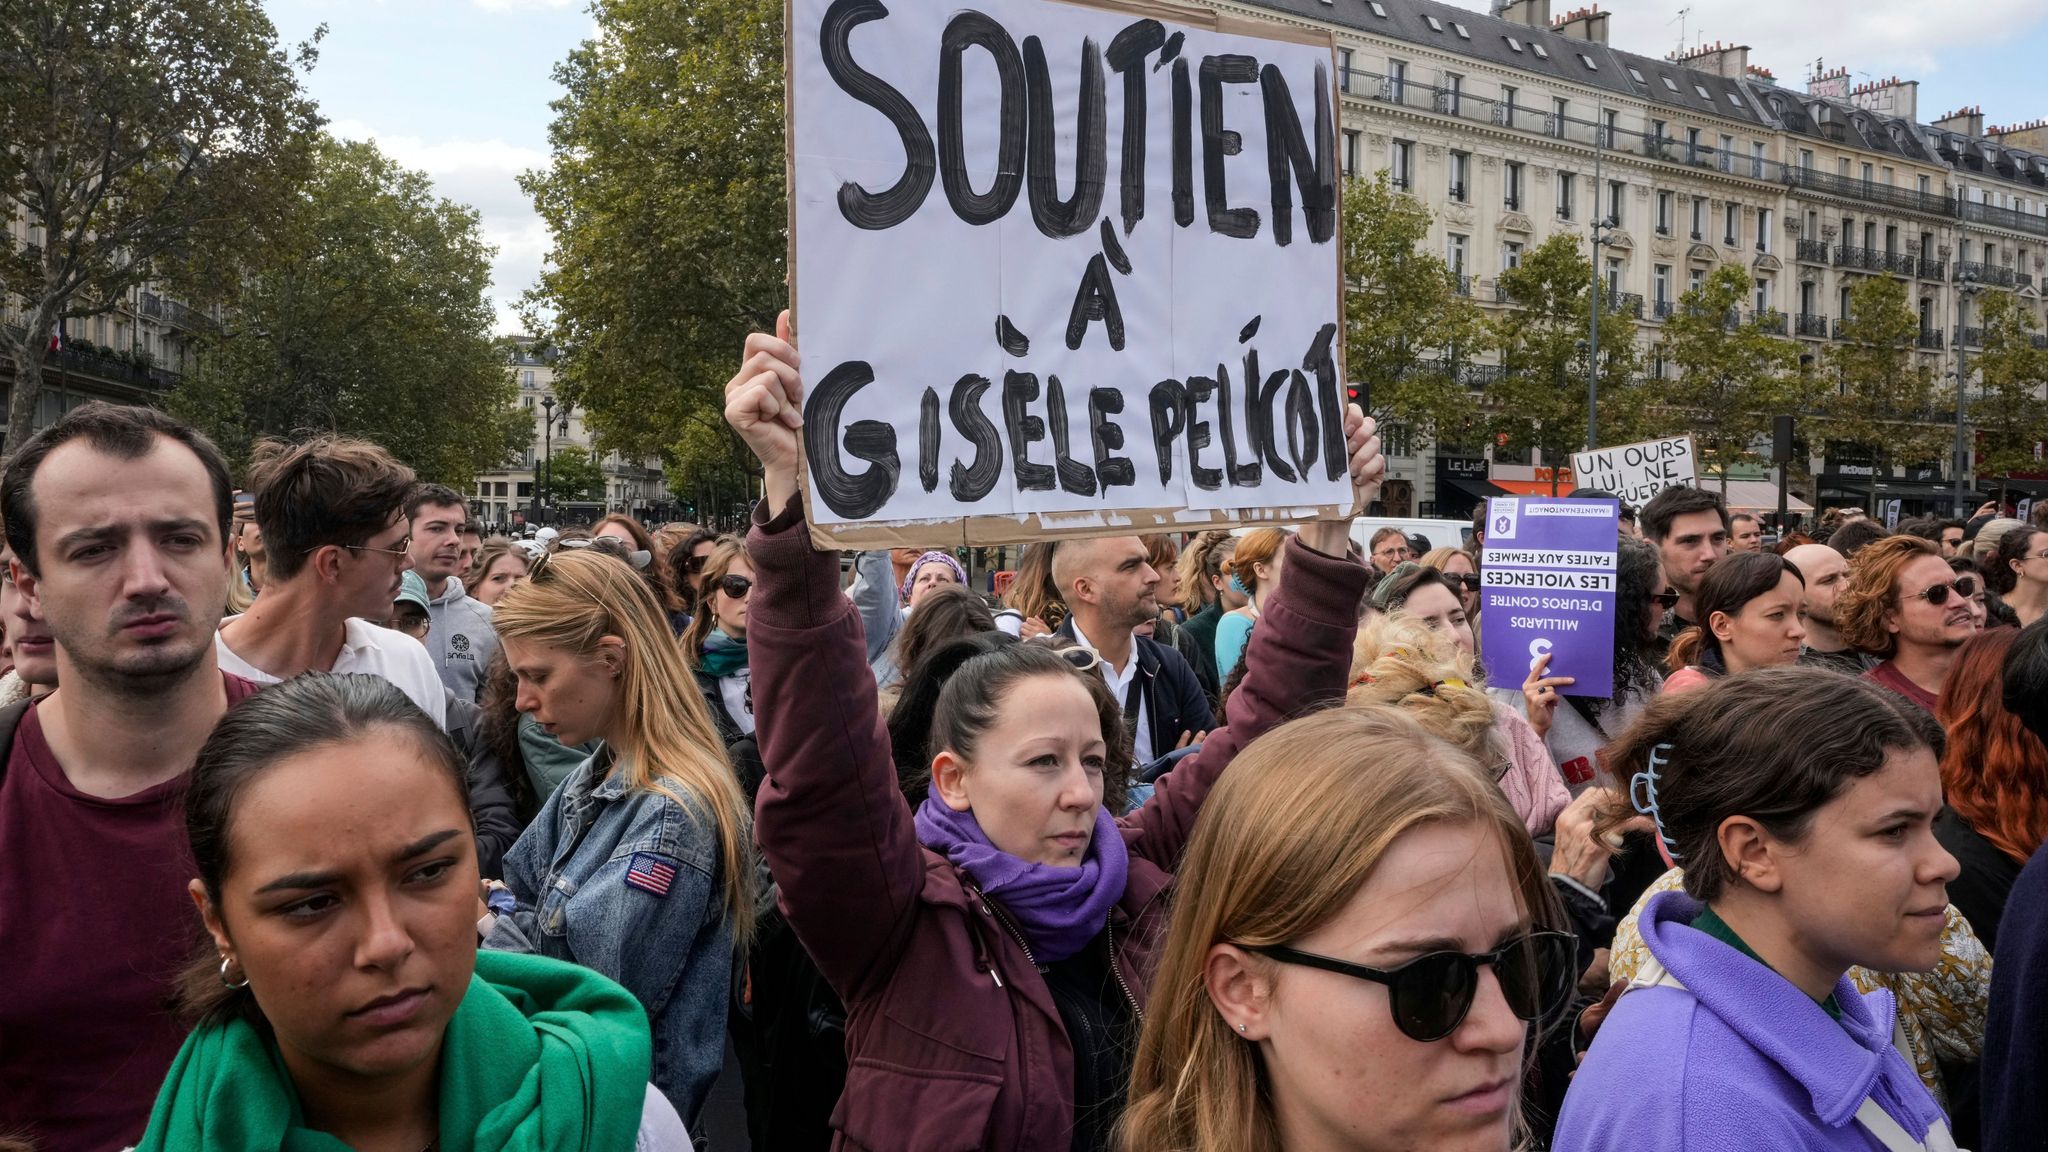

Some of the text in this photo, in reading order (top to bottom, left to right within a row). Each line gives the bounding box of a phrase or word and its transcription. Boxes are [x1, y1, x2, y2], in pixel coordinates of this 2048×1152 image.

[820, 0, 1335, 247] SOUTIEN
[1065, 216, 1132, 351] À
[803, 315, 1347, 519] GISÈLE PELICOT
[1577, 453, 1612, 474] UN
[1645, 459, 1678, 482] NE
[1488, 552, 1610, 566] FAITES AUX FEMMES
[1486, 571, 1610, 590] LES VIOLENCES
[1490, 595, 1603, 612] D'EUROS CONTRE
[1510, 616, 1579, 631] MILLIARDS
[1529, 637, 1553, 676] 3
